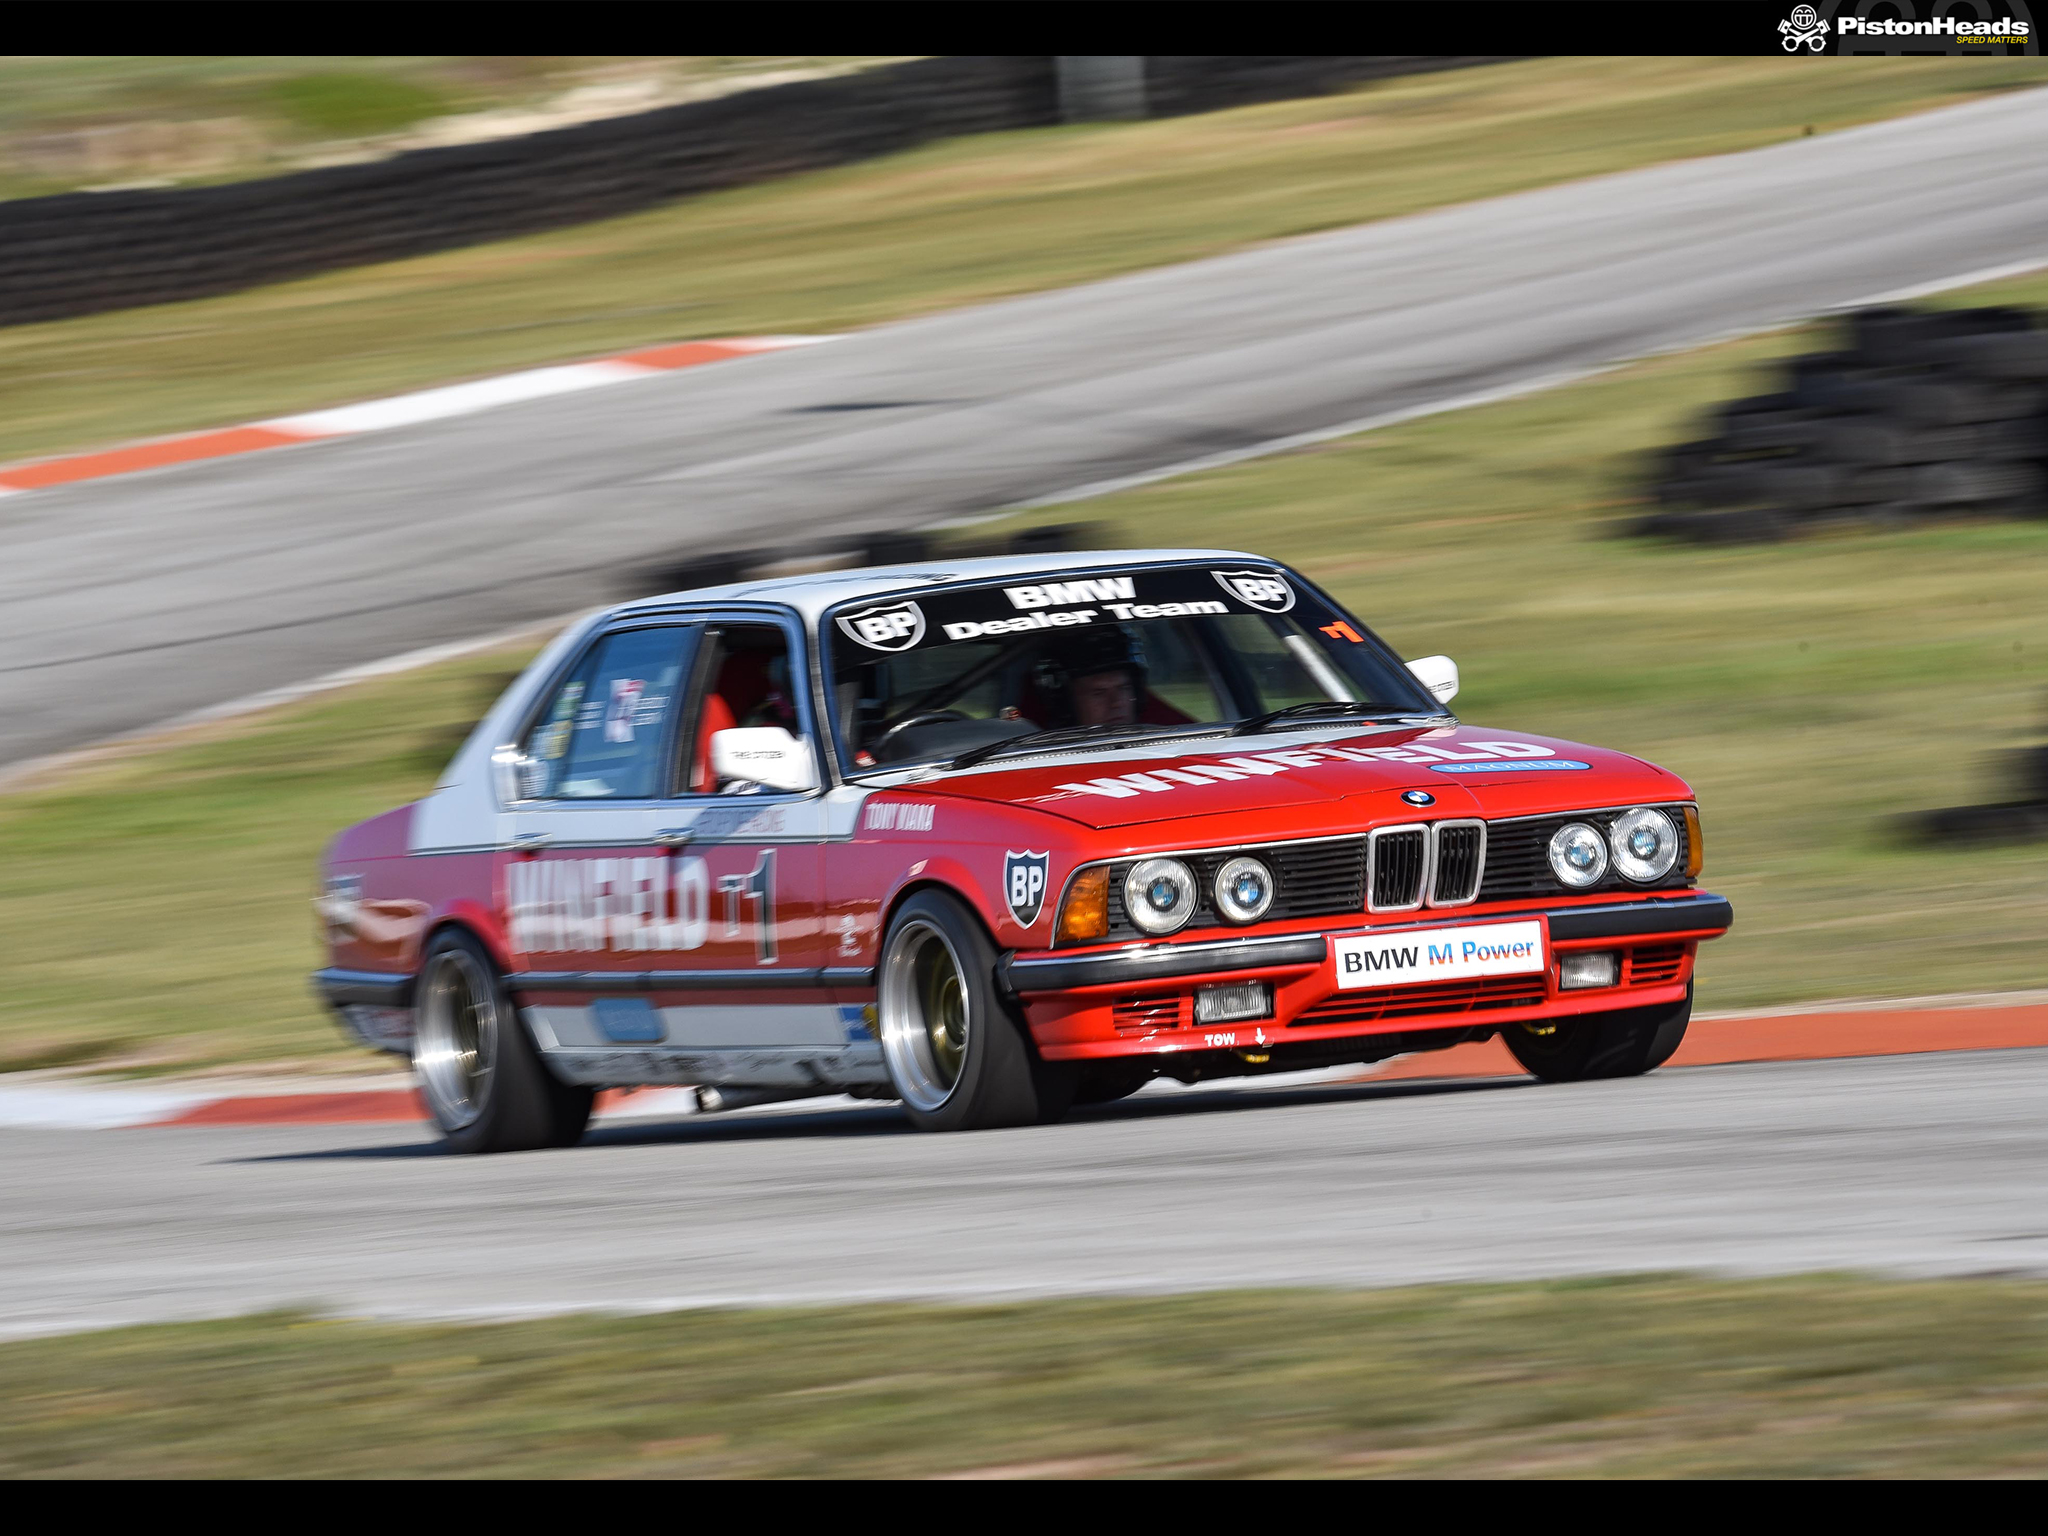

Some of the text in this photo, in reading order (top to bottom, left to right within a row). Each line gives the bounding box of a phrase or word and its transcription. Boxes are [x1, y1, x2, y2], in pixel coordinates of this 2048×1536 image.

[1003, 576, 1137, 610] BMW
[1229, 578, 1288, 602] BP
[854, 611, 919, 644] BP
[941, 600, 1230, 641] Dealer Team
[1051, 741, 1556, 799] WINFIELD
[1445, 760, 1576, 773] MAGNUM
[1011, 865, 1044, 907] BP
[1344, 940, 1535, 974] BMW M Power
[1204, 1032, 1236, 1047] TOW
